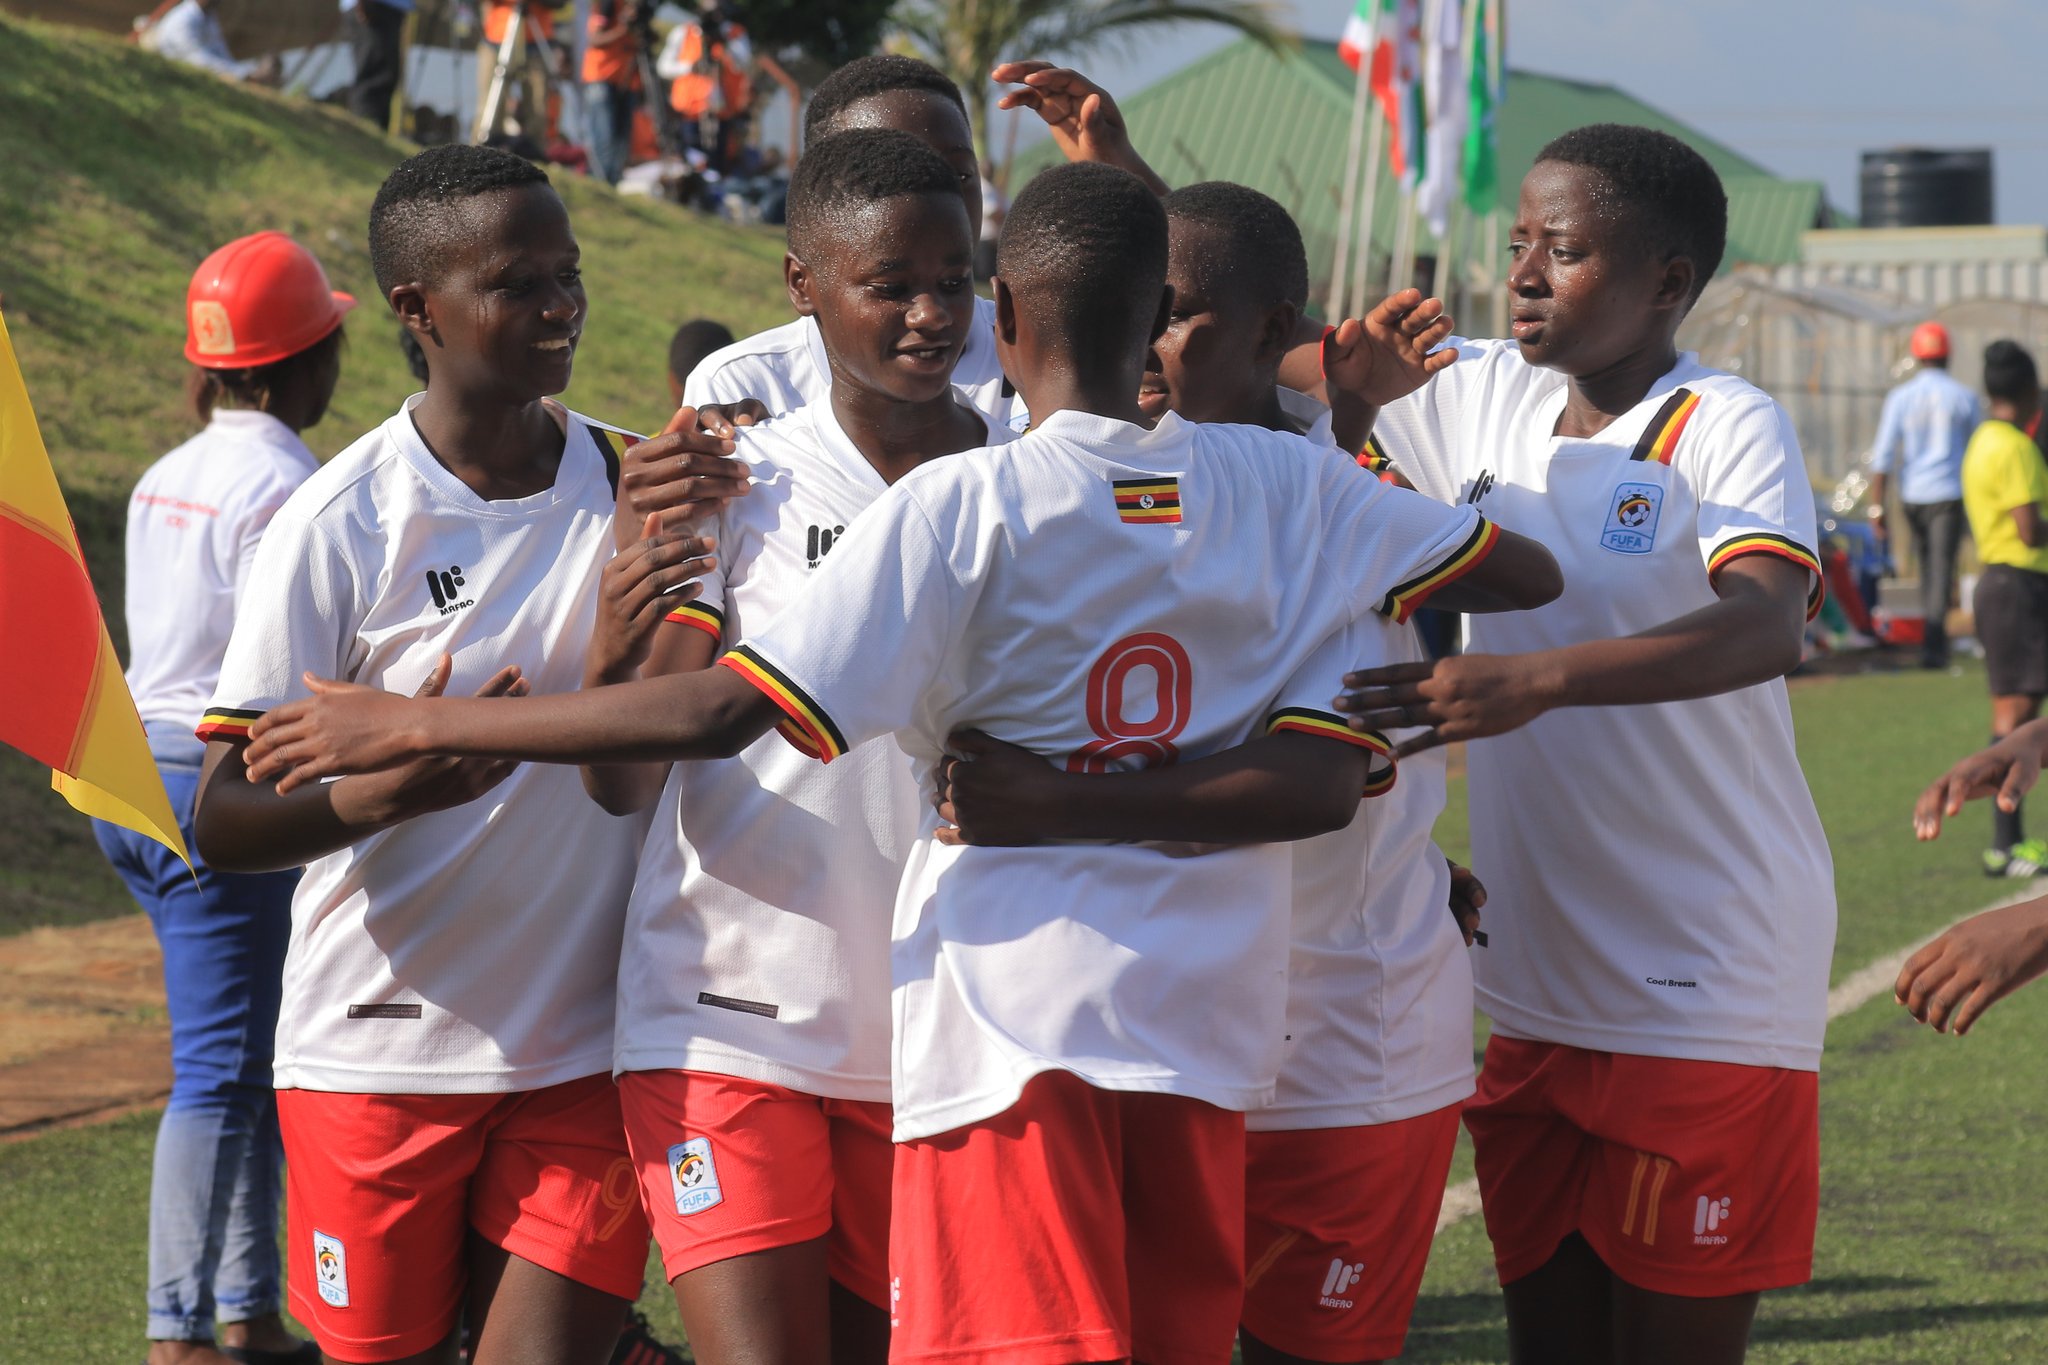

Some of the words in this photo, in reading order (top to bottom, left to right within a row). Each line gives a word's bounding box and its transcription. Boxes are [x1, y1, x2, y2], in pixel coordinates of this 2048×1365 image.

[1610, 534, 1642, 547] FUFA
[440, 599, 474, 616] MAFRO
[1066, 632, 1192, 773] 8
[1646, 977, 1666, 986] Cool
[1668, 979, 1697, 988] Breeze
[597, 1157, 639, 1242] 9
[682, 1192, 711, 1209] FUFA
[1694, 1236, 1727, 1245] MAFRO
[321, 1285, 340, 1301] FUFA
[1320, 1297, 1353, 1309] MAFRO
